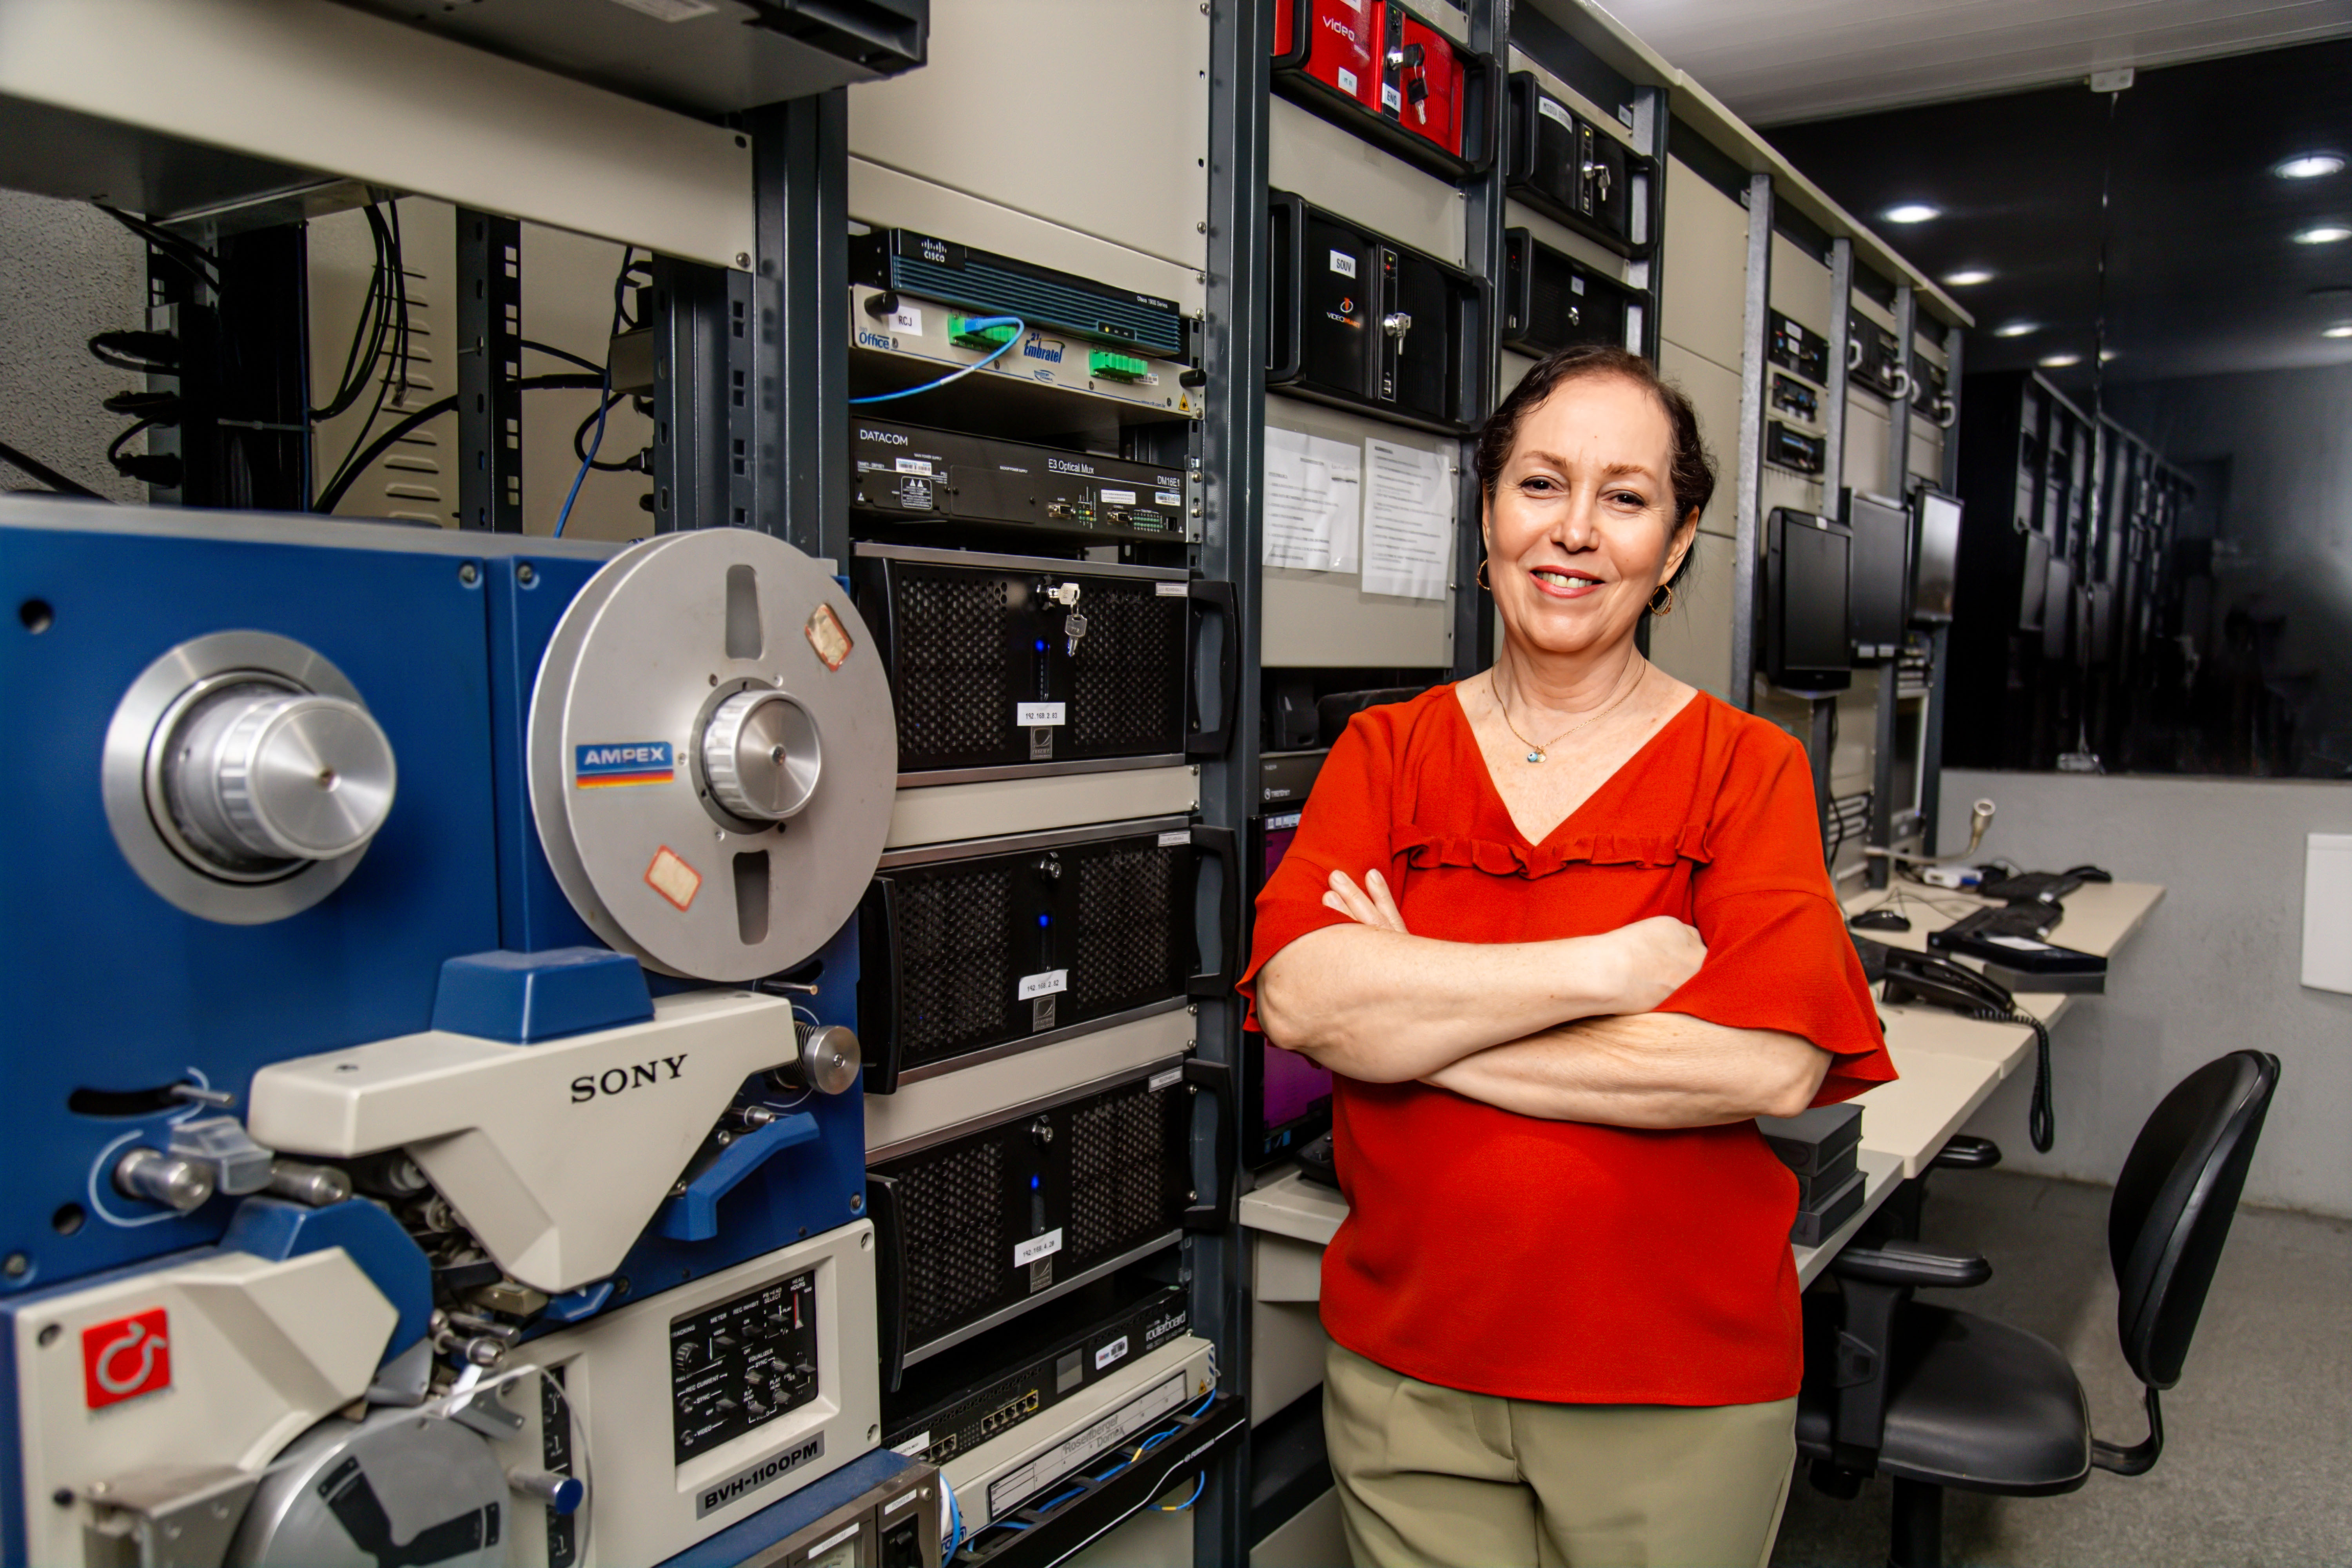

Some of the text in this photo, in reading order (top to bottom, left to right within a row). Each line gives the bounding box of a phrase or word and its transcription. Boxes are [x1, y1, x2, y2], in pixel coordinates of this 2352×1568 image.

[1387, 91, 1397, 106] ENG
[924, 250, 945, 263] CISCO
[1336, 258, 1352, 272] SOUV
[1137, 295, 1147, 303] Cisco
[898, 315, 912, 327] RCJ
[859, 332, 889, 350] Office
[1024, 338, 1064, 364] Embratel
[860, 429, 908, 446] DATACOM
[1049, 458, 1094, 474] E3 Optical Mux
[1157, 475, 1180, 487] DM16E1
[584, 747, 664, 766] AMPEX
[1027, 979, 1059, 992] 192.168.2.82
[571, 1053, 688, 1104] SONY
[1023, 1240, 1054, 1258] 192.168.4.20
[790, 1281, 806, 1291] HOURS
[792, 1276, 804, 1285] HEAD
[764, 1293, 781, 1304] SELECT
[733, 1300, 759, 1315] REC INHIBIT
[710, 1312, 727, 1324] METER
[671, 1324, 696, 1338] TRACKING
[713, 1327, 725, 1336] VIDEO
[1145, 1310, 1186, 1341] routerboard
[748, 1348, 773, 1363] EQUALIZER
[755, 1359, 768, 1368] SYNC
[686, 1374, 719, 1393] REC CURRENT
[769, 1377, 781, 1386] PLAY
[696, 1393, 710, 1404] SYNC
[744, 1388, 753, 1397] R/P
[744, 1394, 754, 1402] HEAD
[697, 1425, 712, 1436] VIDEO
[705, 1440, 818, 1509] BVH-1100PM
[891, 1494, 910, 1509] POWER
